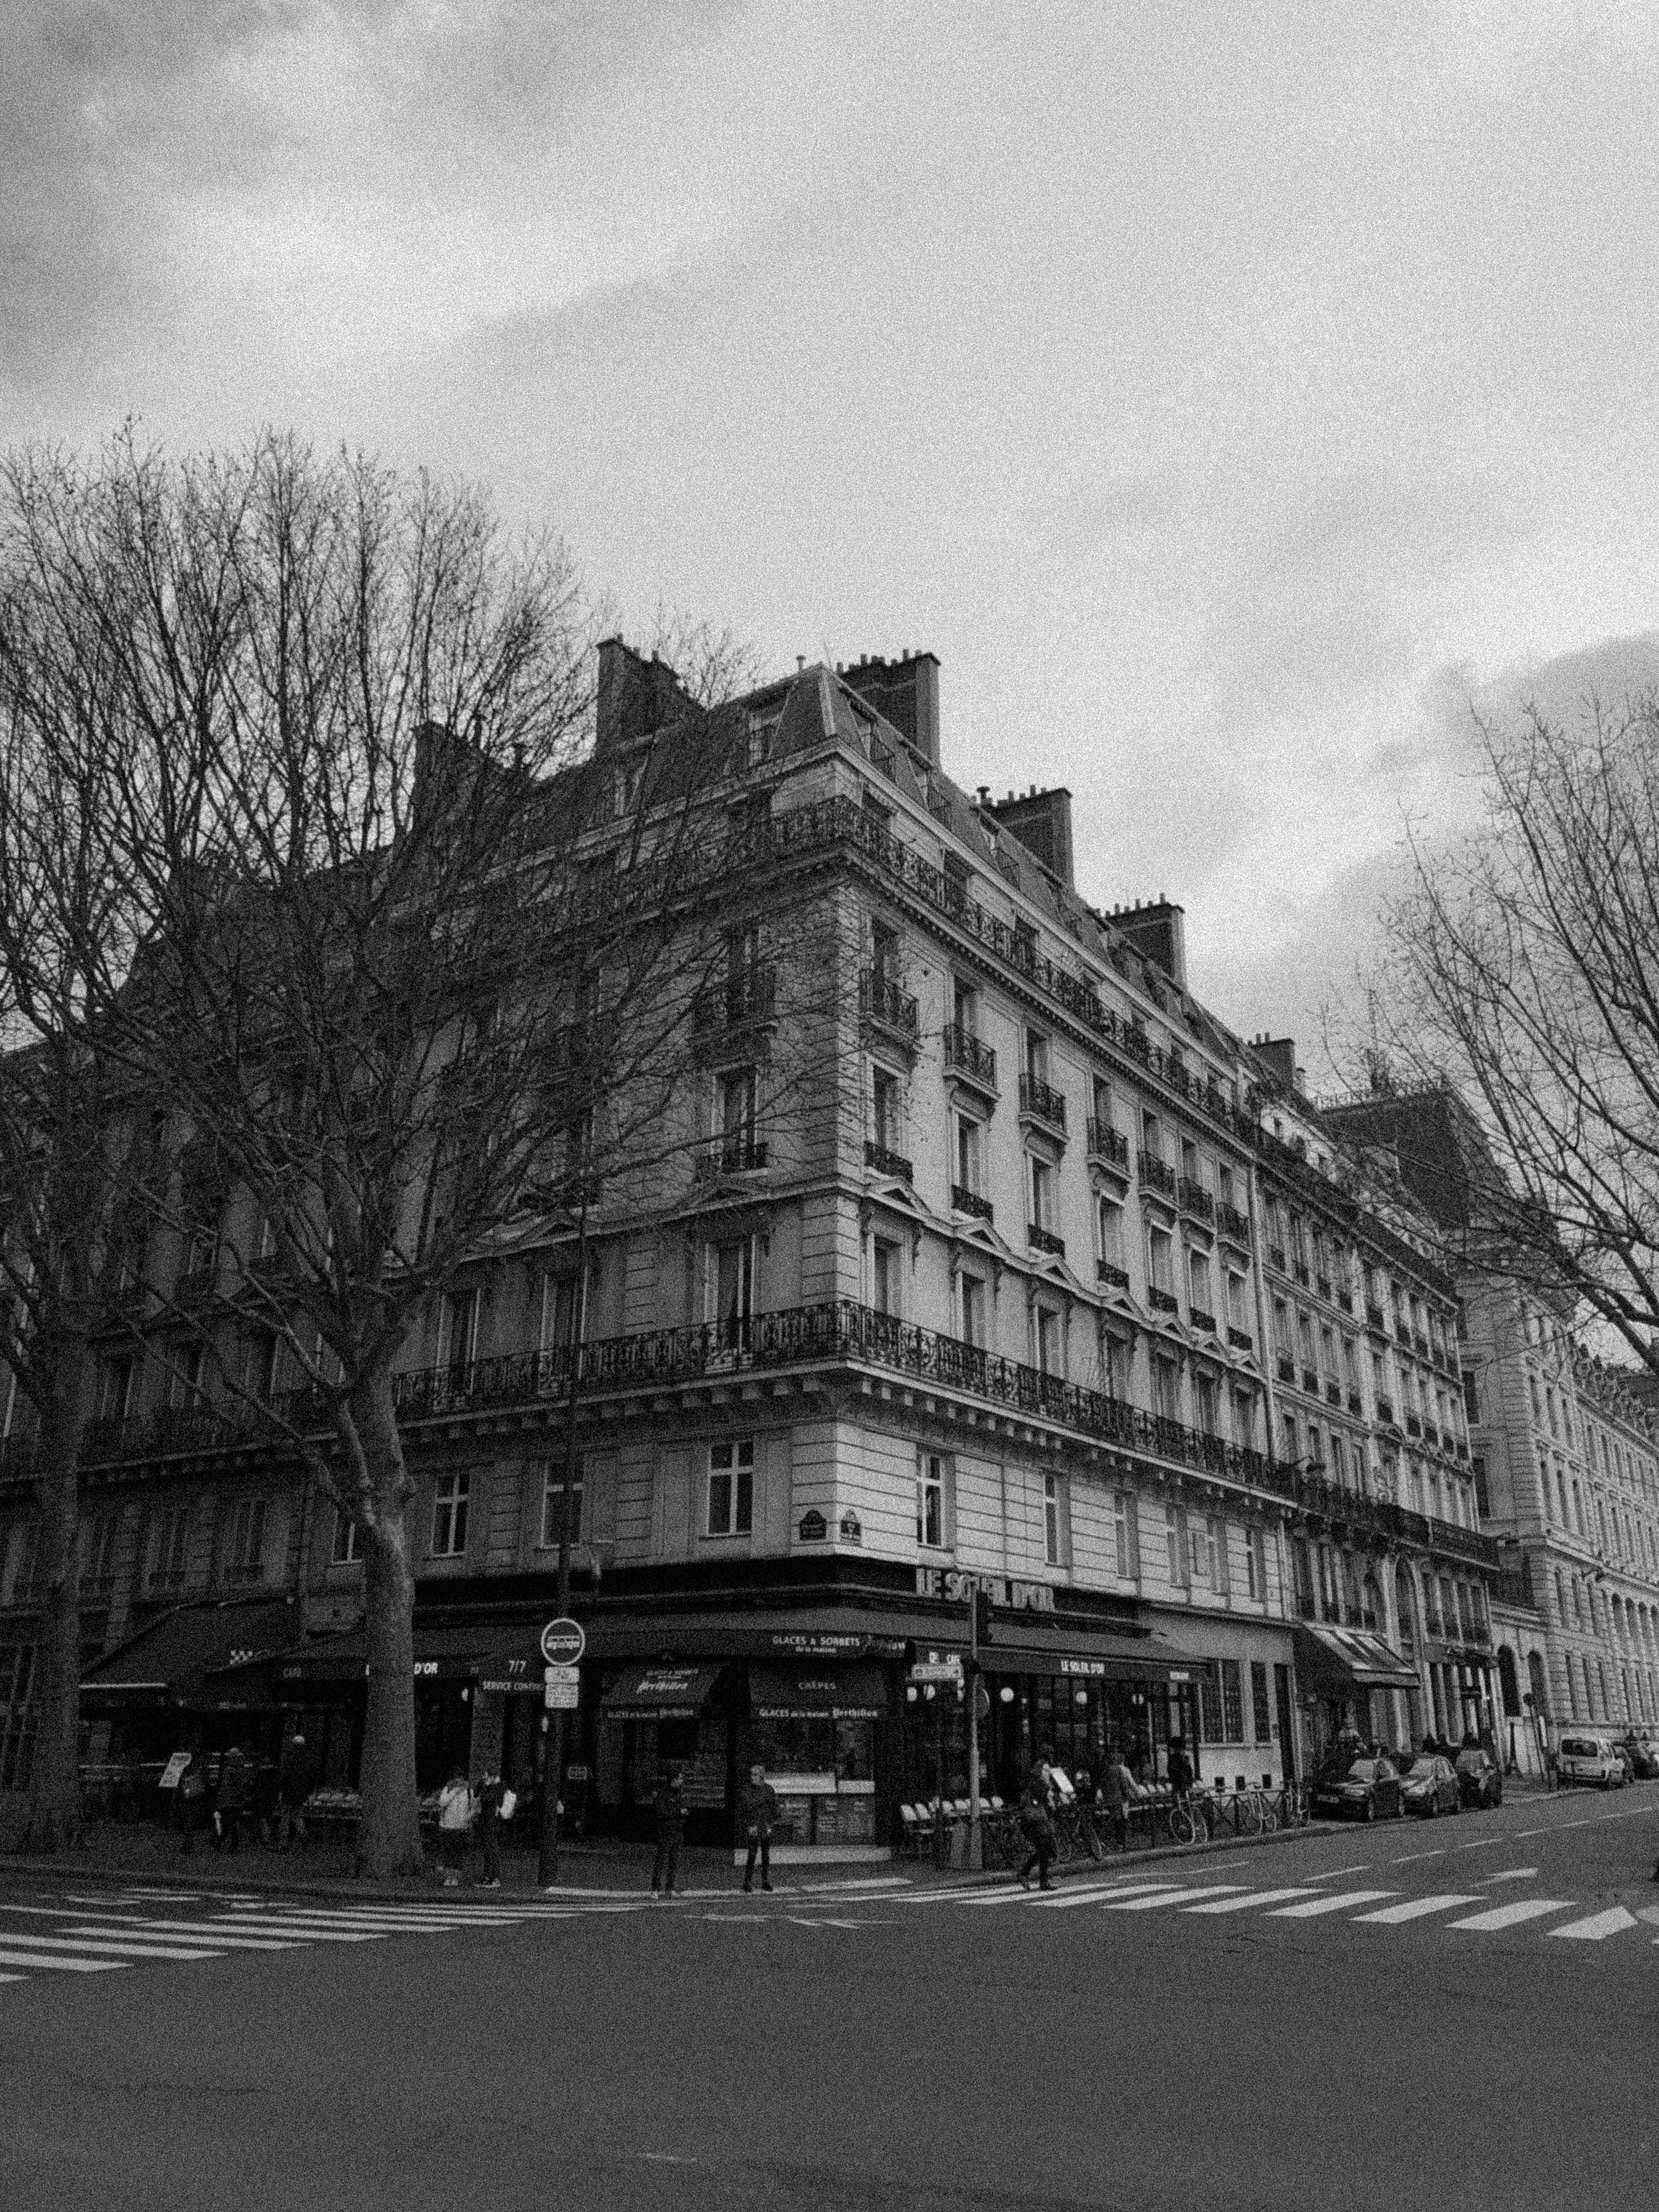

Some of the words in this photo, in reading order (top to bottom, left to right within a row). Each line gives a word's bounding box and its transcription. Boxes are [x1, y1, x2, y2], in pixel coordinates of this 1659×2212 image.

[916, 1567, 942, 1599] LE
[772, 1636, 806, 1645] GLACES
[820, 1637, 860, 1646] SORBETS
[414, 1662, 438, 1675] D'OR
[509, 1660, 527, 1673] 7/7
[482, 1680, 511, 1691] SERVICE
[759, 1708, 789, 1717] GLACES
